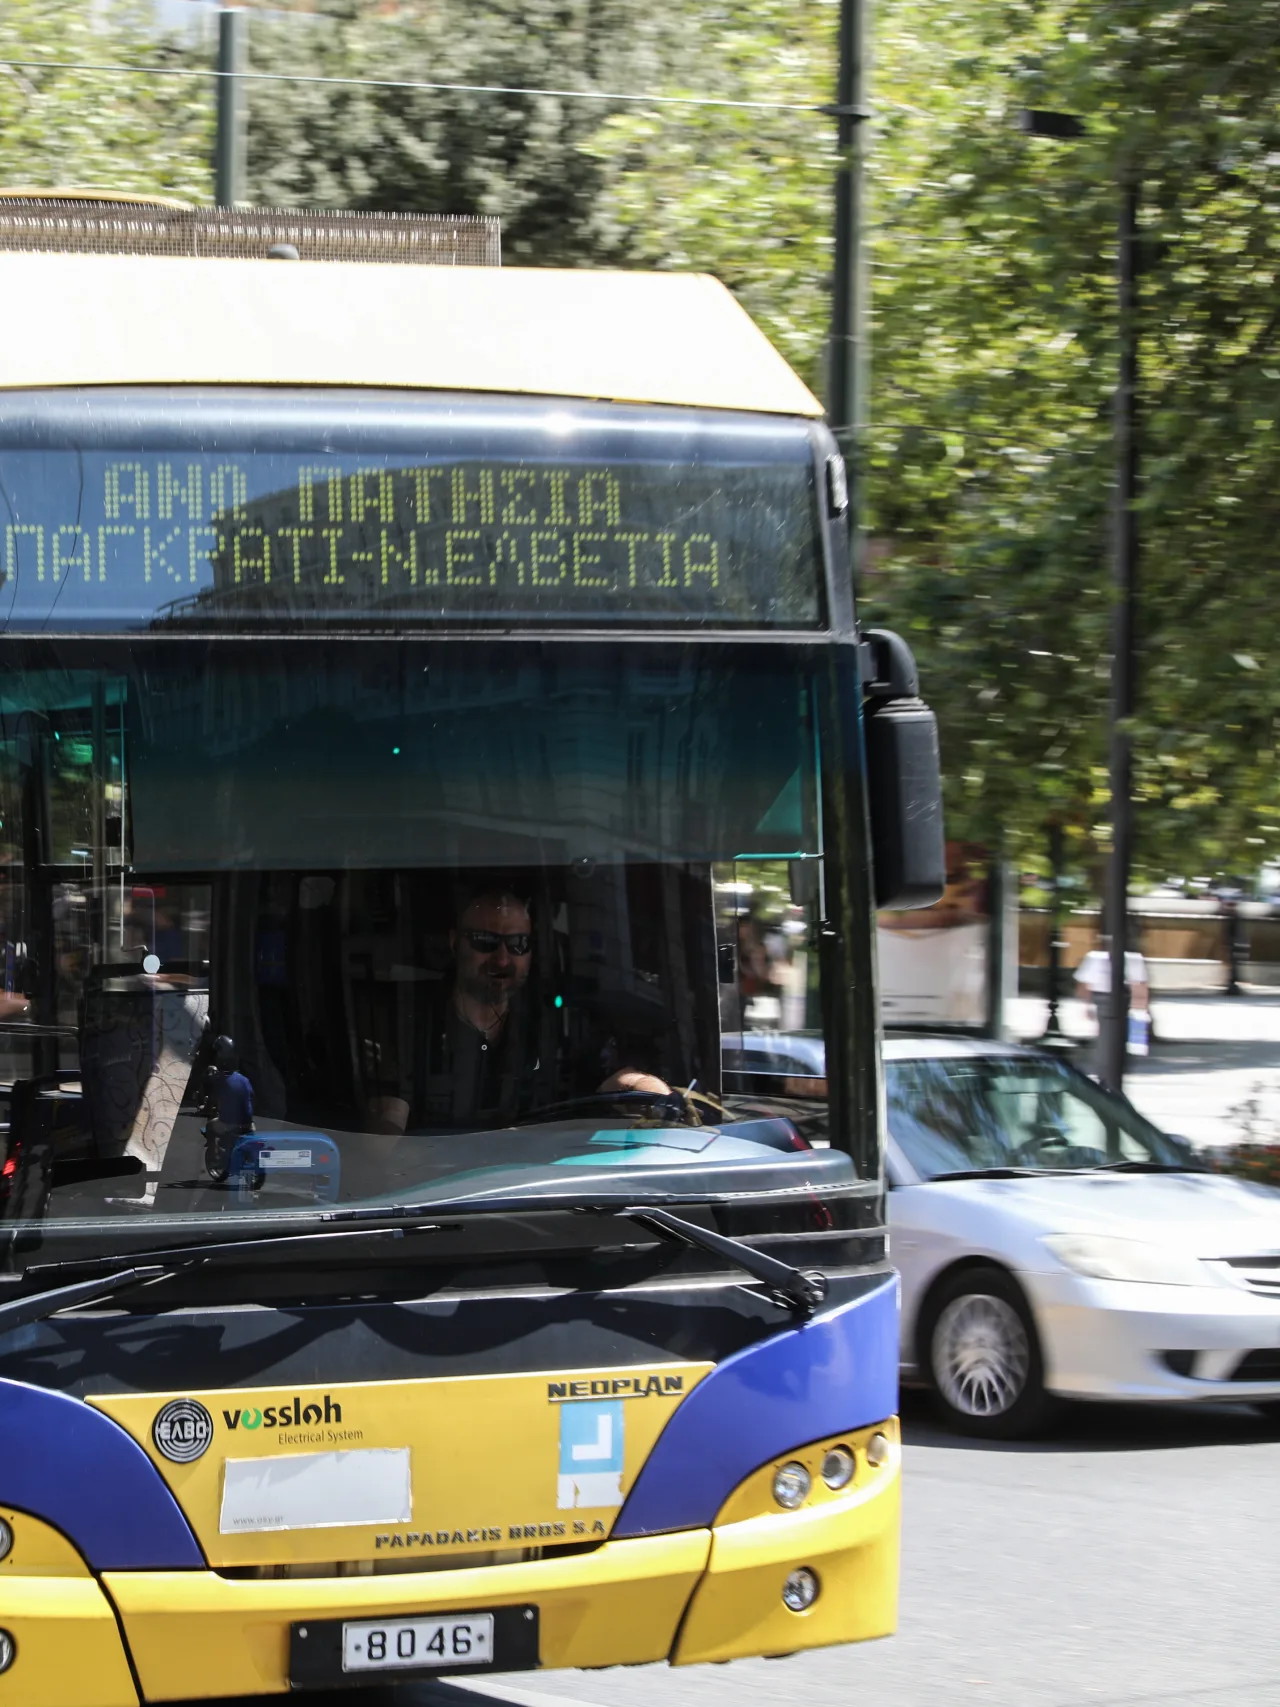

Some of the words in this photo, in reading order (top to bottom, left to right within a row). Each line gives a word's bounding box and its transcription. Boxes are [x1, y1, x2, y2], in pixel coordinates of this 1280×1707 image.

[104, 462, 247, 520] ΑΝΩ
[298, 466, 620, 527] ΠΑΤΗΣΙΑ
[548, 1375, 683, 1397] NEOPLAN
[222, 1395, 342, 1429] vossloh
[278, 1430, 324, 1445] Electrical
[327, 1429, 363, 1444] System
[375, 1526, 502, 1549] PAPADAKIS
[508, 1520, 567, 1540] BROS
[366, 1625, 472, 1661] 8046
